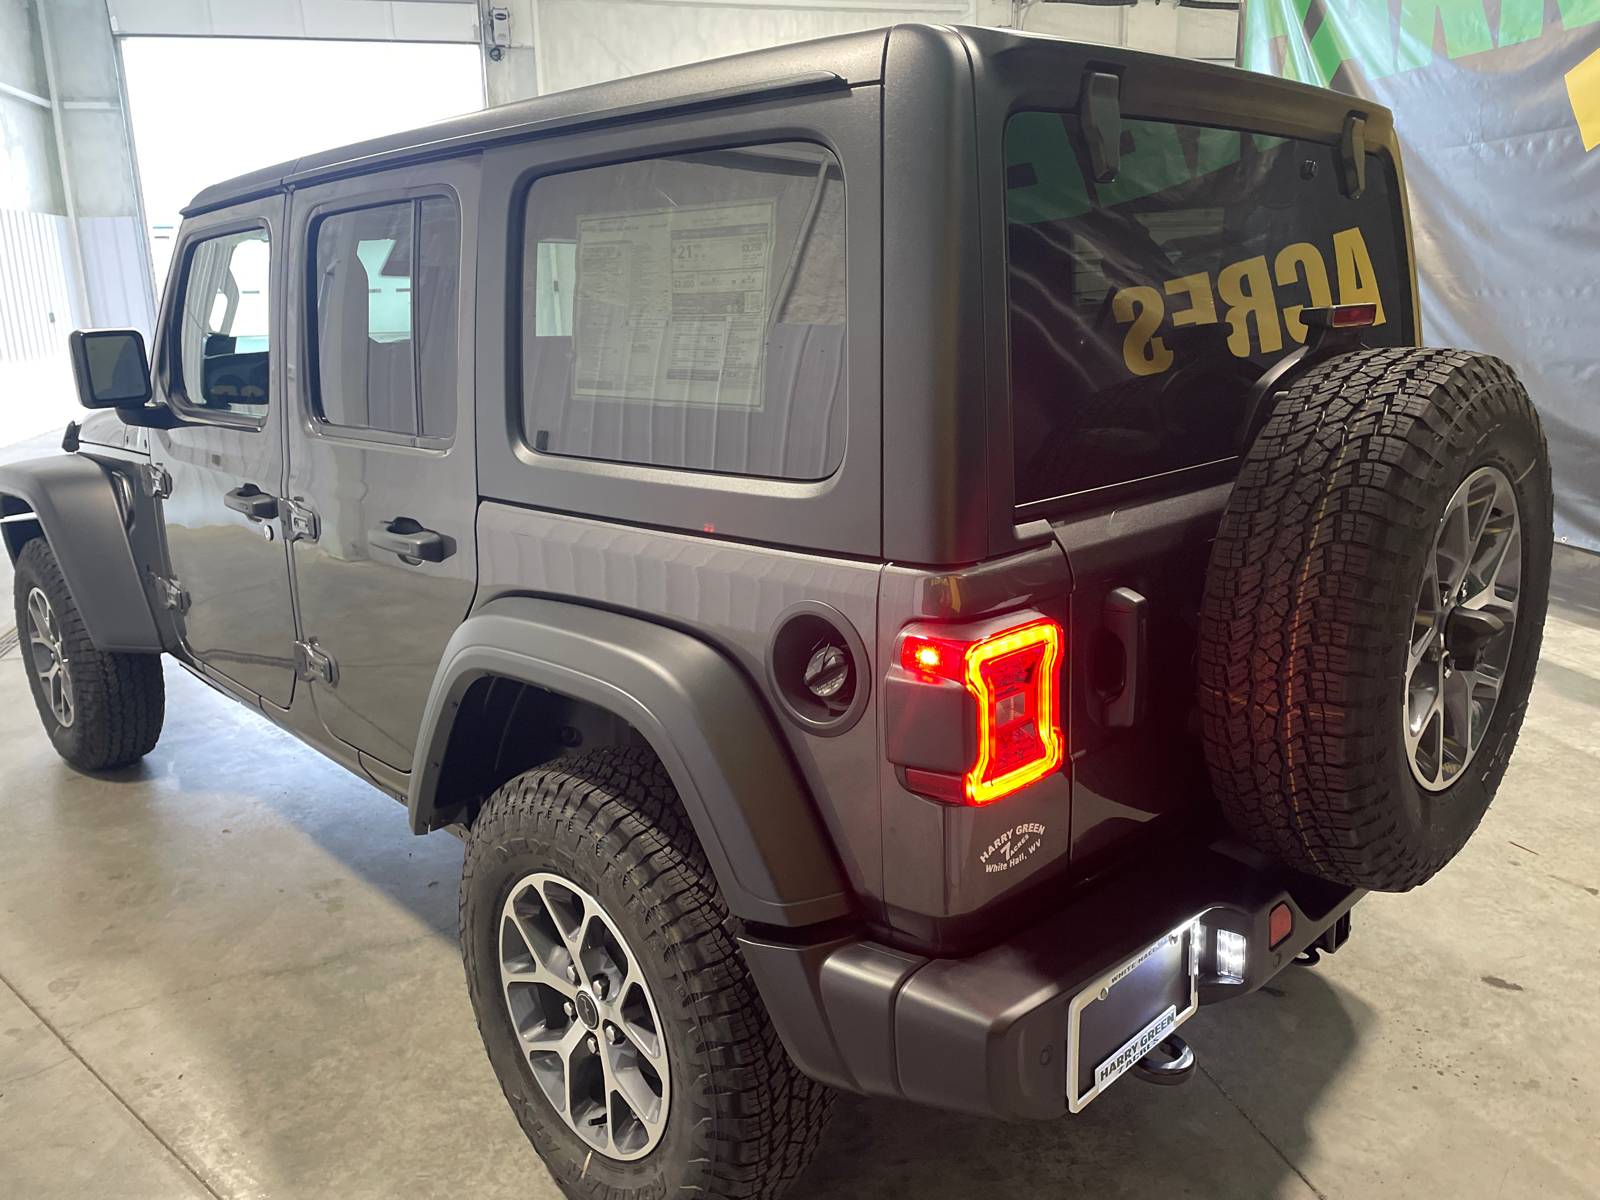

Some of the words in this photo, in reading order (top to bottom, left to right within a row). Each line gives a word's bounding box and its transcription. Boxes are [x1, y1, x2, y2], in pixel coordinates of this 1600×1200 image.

[678, 245, 691, 260] 21
[980, 829, 1013, 863] HARRY
[1016, 823, 1045, 835] GREEN
[985, 862, 1008, 873] White
[1009, 852, 1027, 868] Hall,
[1028, 838, 1041, 854] WV
[1000, 841, 1011, 861] 7
[1011, 834, 1029, 856] ACRES
[1111, 962, 1137, 983] WHITE
[1100, 1041, 1139, 1082] HARRY
[1140, 1012, 1175, 1047] GREEN
[1126, 1036, 1160, 1068] ACRES
